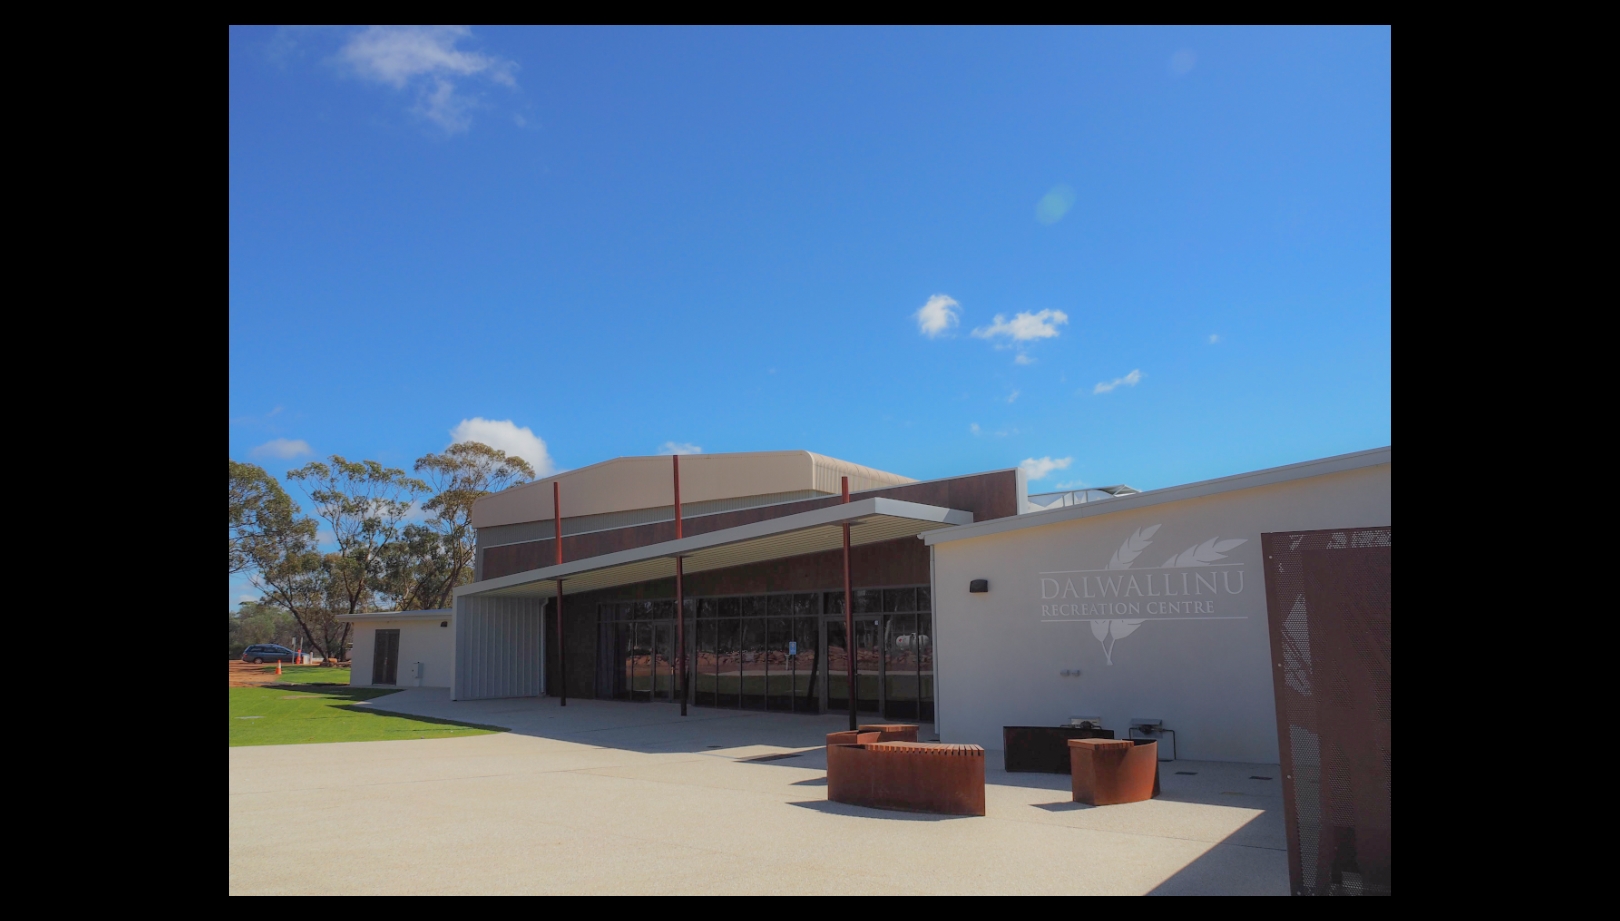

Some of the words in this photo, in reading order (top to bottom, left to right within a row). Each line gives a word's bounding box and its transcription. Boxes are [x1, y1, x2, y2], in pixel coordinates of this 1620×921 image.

[1040, 570, 1245, 600] DALWALLINU
[1041, 602, 1140, 617] RECREATION
[1146, 600, 1215, 615] CENTRE
